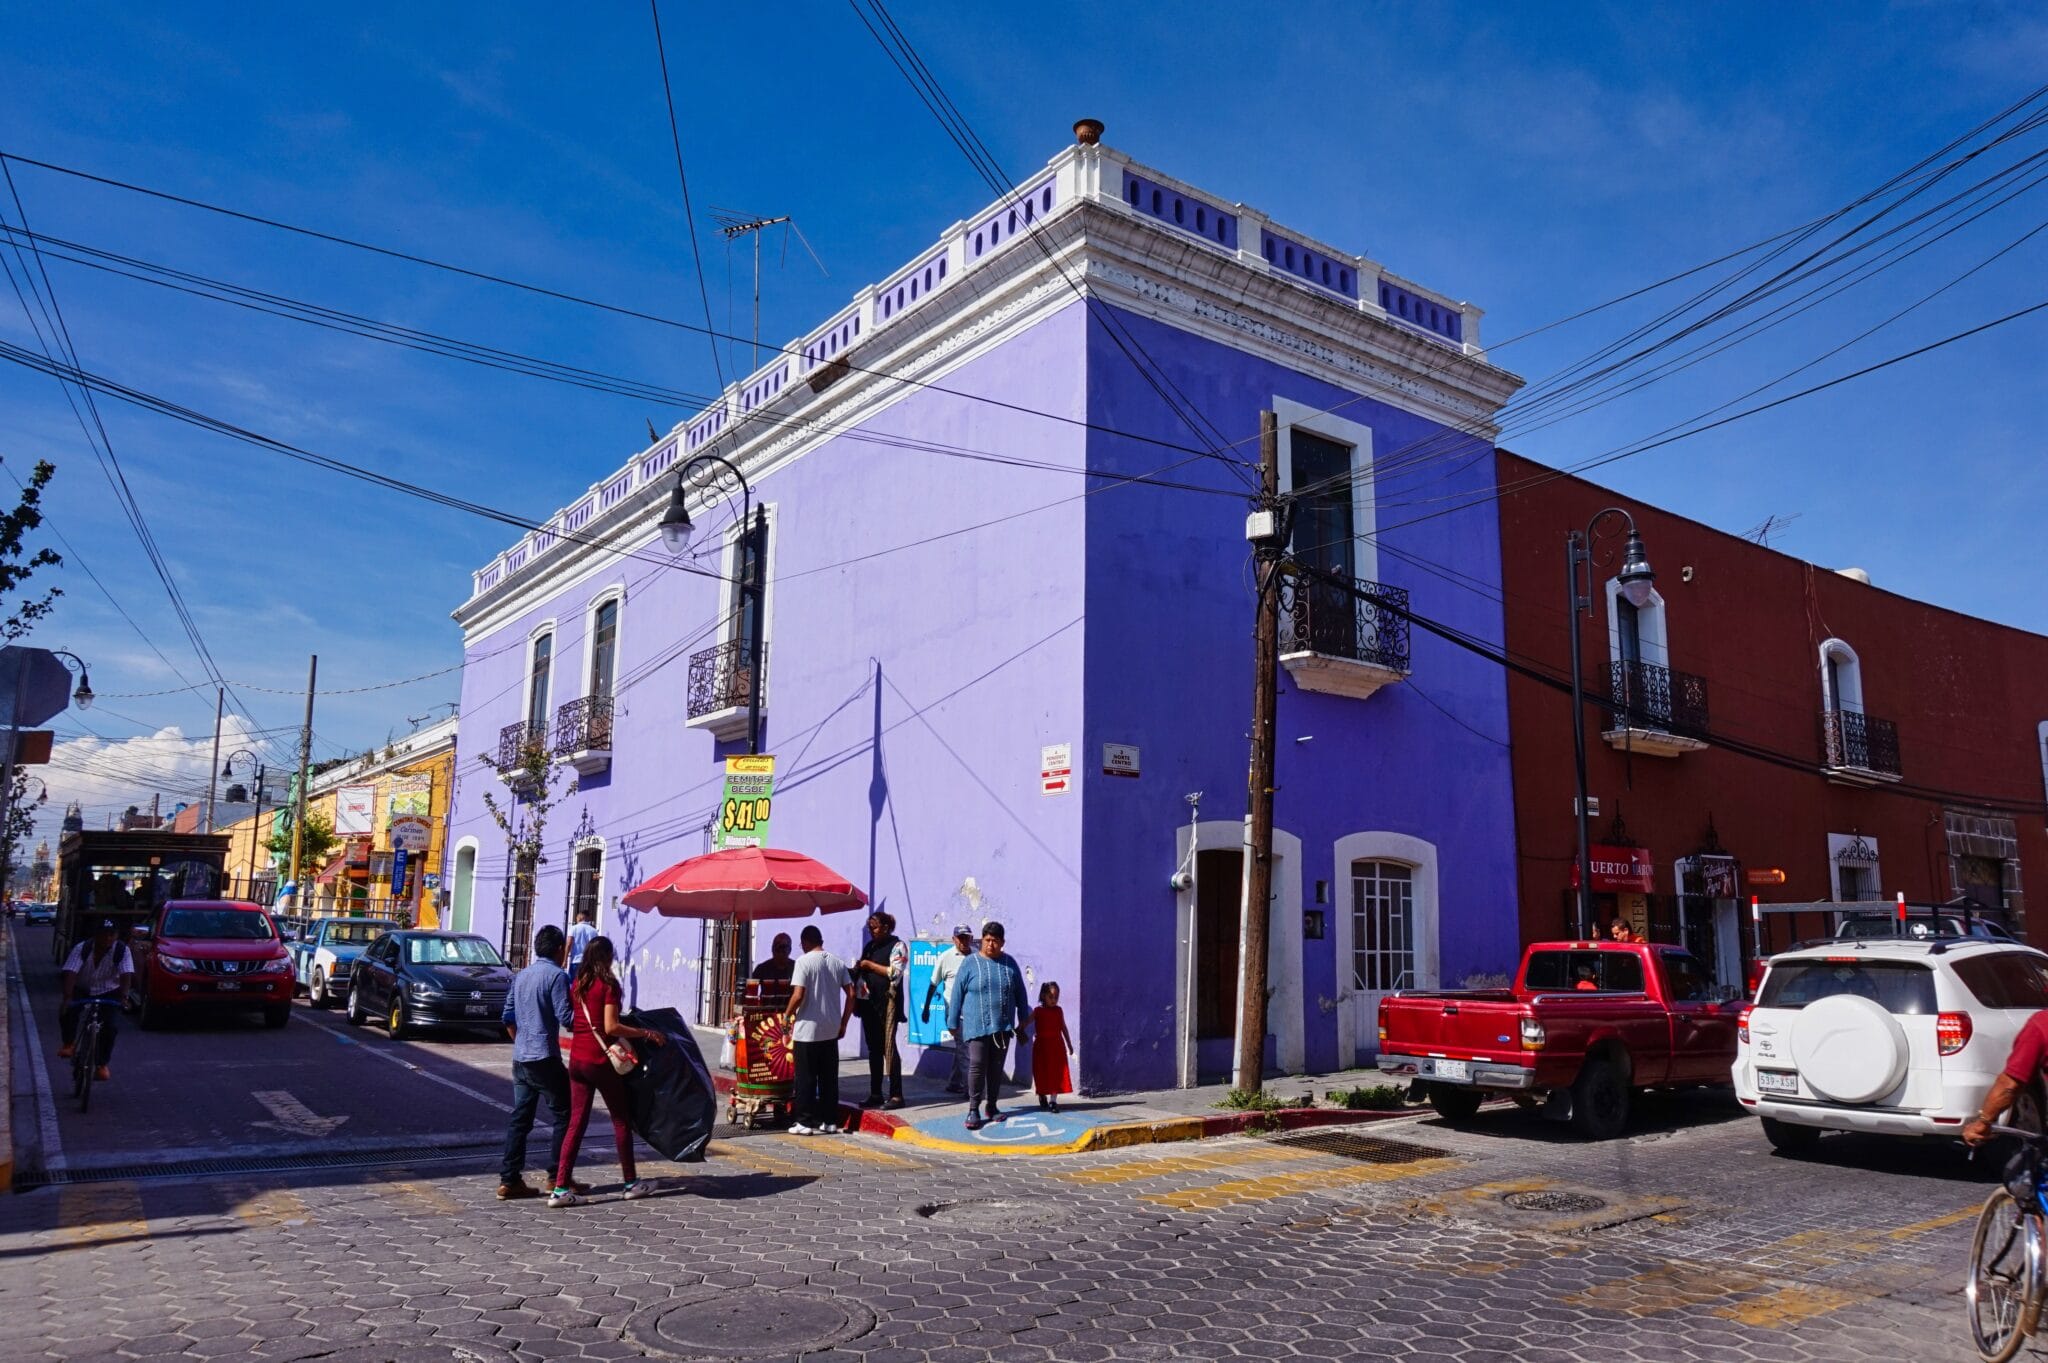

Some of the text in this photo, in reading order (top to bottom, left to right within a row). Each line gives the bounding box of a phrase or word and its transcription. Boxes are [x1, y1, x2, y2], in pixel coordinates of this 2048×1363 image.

[727, 775, 772, 784] CEMITAS
[731, 785, 766, 793] DESDE
[1590, 861, 1629, 875] UERTO
[751, 1017, 776, 1041] RICO
